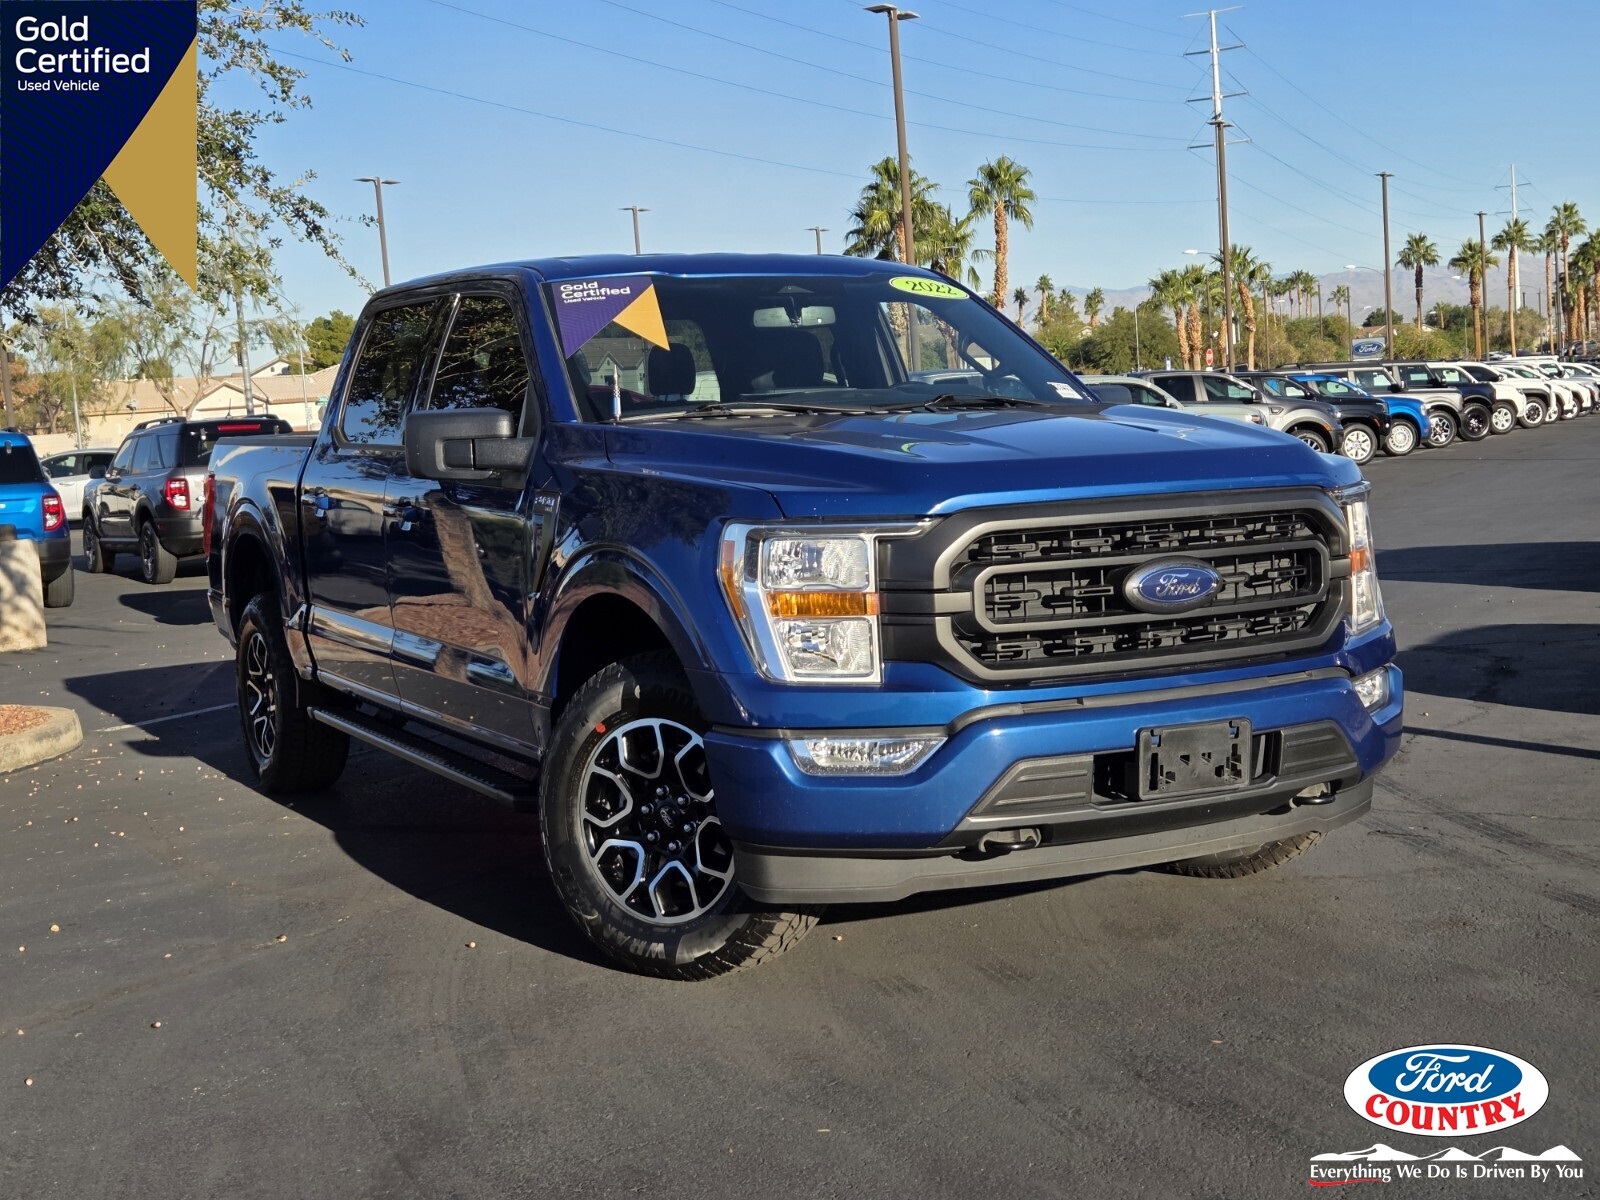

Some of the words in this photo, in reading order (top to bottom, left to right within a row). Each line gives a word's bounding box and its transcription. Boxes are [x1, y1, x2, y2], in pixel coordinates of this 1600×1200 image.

[560, 281, 598, 292] Gold
[905, 280, 957, 295] 2022
[561, 287, 631, 299] Certified
[1358, 344, 1378, 353] Ford
[1155, 572, 1201, 597] Ford
